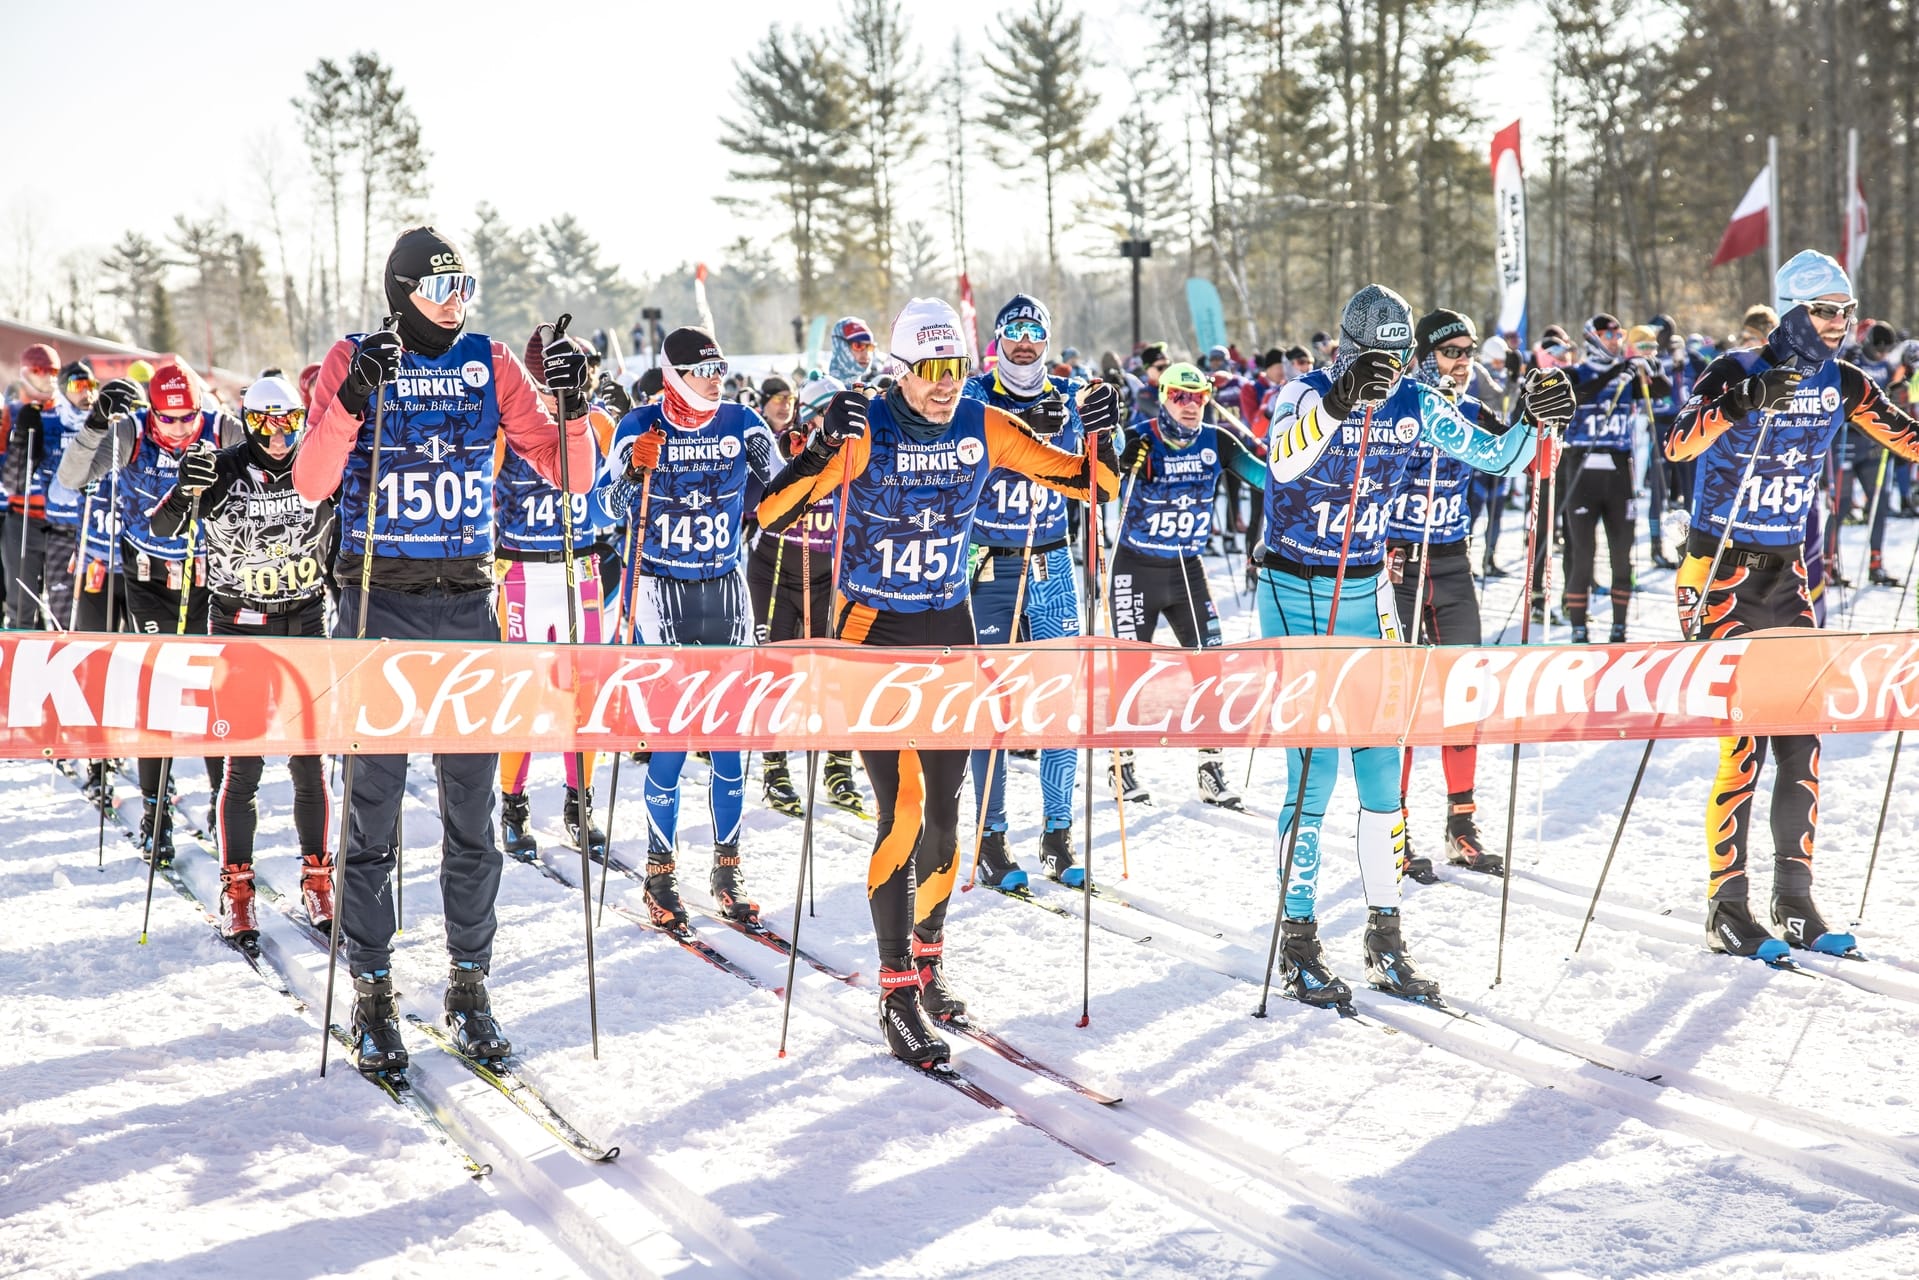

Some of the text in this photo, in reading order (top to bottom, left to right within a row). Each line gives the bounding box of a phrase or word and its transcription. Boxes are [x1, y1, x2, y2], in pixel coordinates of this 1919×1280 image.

[473, 373, 479, 383] 1
[397, 378, 465, 397] BIRKIE
[383, 400, 482, 412] Ski. Run. Bike. Live!
[1790, 397, 1821, 414] RKIE
[1827, 398, 1836, 408] 14
[668, 435, 719, 445] slumberland
[1403, 429, 1414, 440] 13
[668, 445, 720, 462] BIRKIE
[727, 446, 733, 455] 7
[897, 440, 956, 452] slumberland
[968, 449, 974, 460] 1
[672, 464, 690, 472] Run.
[693, 464, 712, 472] Bike.
[714, 462, 734, 470] Live!
[897, 452, 960, 472] BIRKIE
[1164, 460, 1204, 475] BIRKIE
[882, 471, 974, 486] Ski. Run. Bike. Live!
[378, 471, 483, 520] 1505
[250, 497, 301, 517] BIRKIE
[1395, 493, 1462, 526] 1308
[655, 512, 730, 552] 1438
[1146, 512, 1211, 538] 1592
[352, 529, 449, 544] 2022 merican Birkebeiner
[1281, 536, 1296, 548] 2022
[1297, 543, 1328, 556] American
[874, 531, 966, 582] 1457
[236, 557, 318, 596] 1019
[861, 585, 894, 599] American
[894, 592, 933, 600] Birkebeiner
[1134, 592, 1145, 626] TEAM
[0, 639, 226, 735] KIE
[355, 647, 1372, 737] Ski. Run. Bike. Live!
[1443, 640, 1750, 728] BIRKIE
[882, 974, 920, 984] MADSHUS
[889, 1009, 921, 1052] MADSHUS
